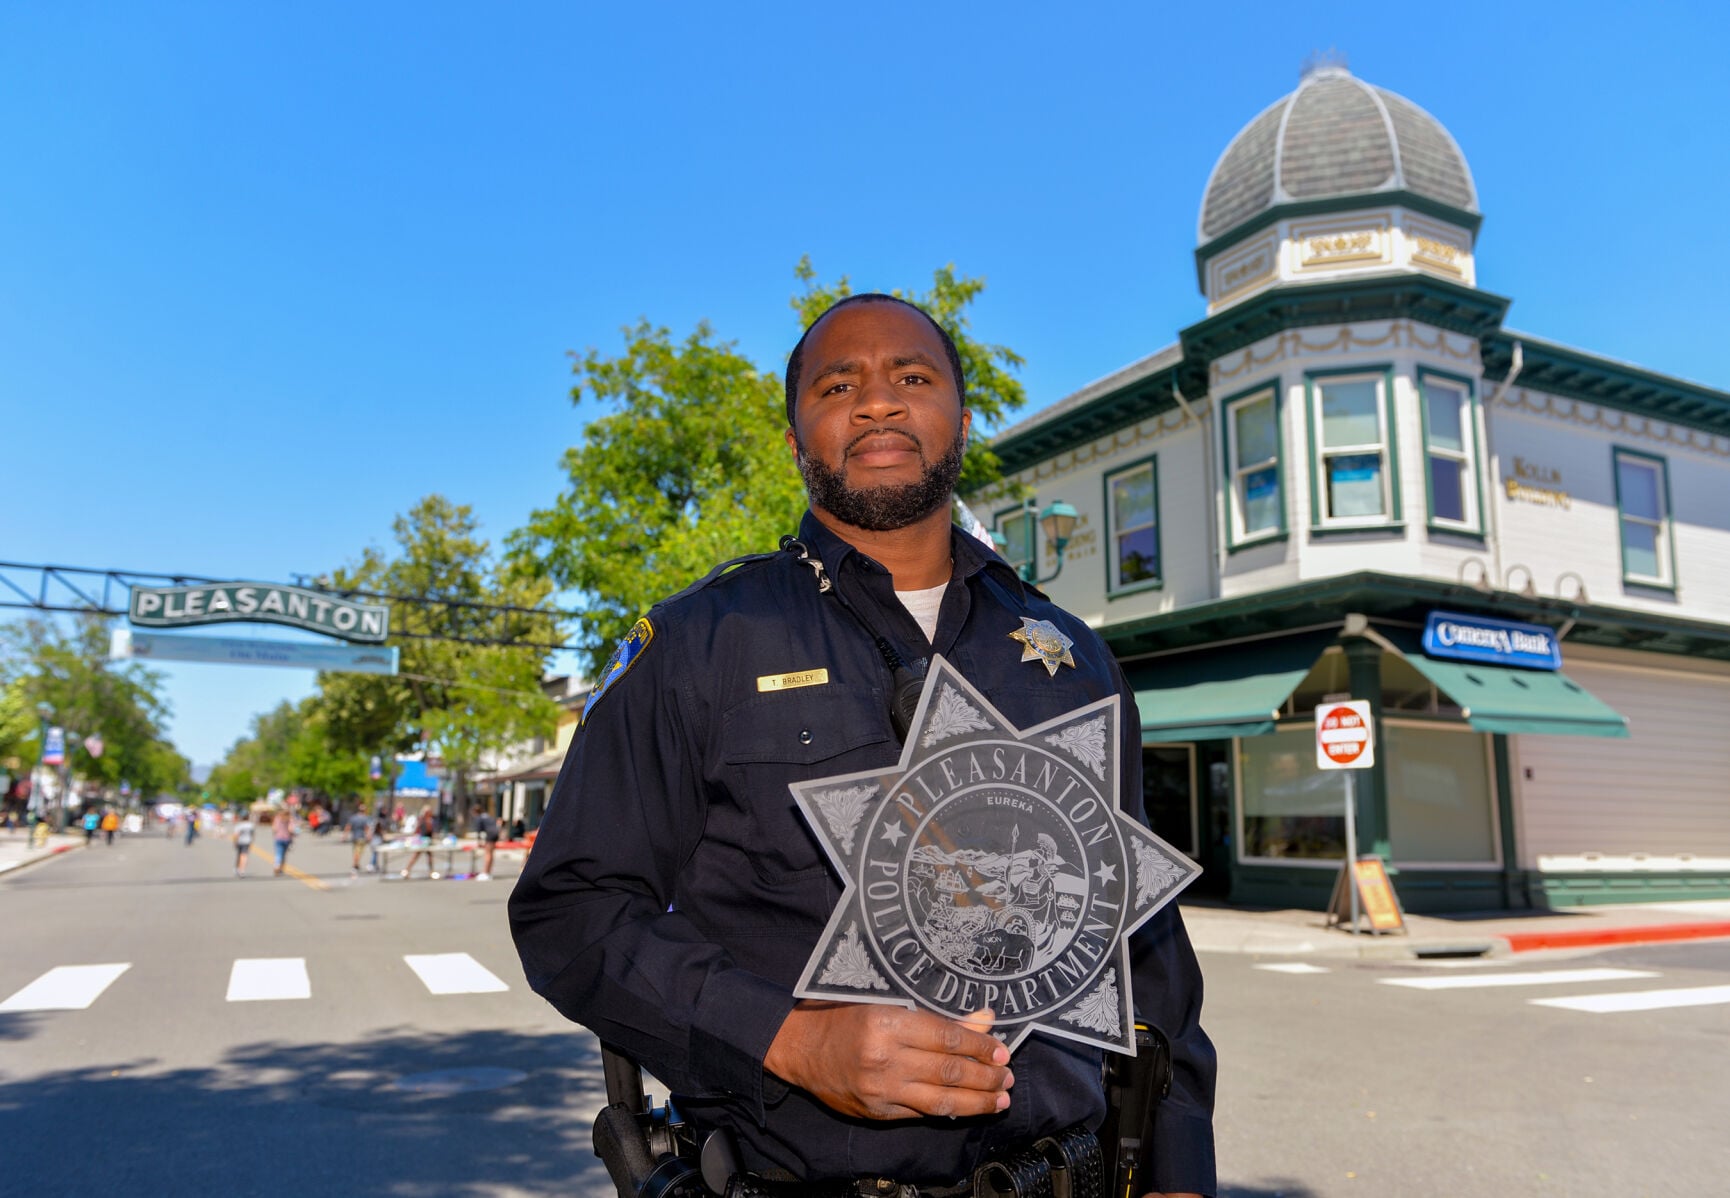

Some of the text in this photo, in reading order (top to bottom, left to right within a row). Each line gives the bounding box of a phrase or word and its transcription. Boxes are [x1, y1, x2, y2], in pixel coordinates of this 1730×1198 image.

[137, 587, 381, 635] PLEASANTON
[1512, 630, 1550, 655] Bank
[782, 674, 814, 685] BRADLEY
[1340, 714, 1360, 728] NOT
[1328, 742, 1360, 755] ENTER
[899, 747, 1113, 847] PLEASANTON
[986, 796, 1033, 814] EUREKA
[867, 859, 1120, 1015] POLICE DEPARTMENT
